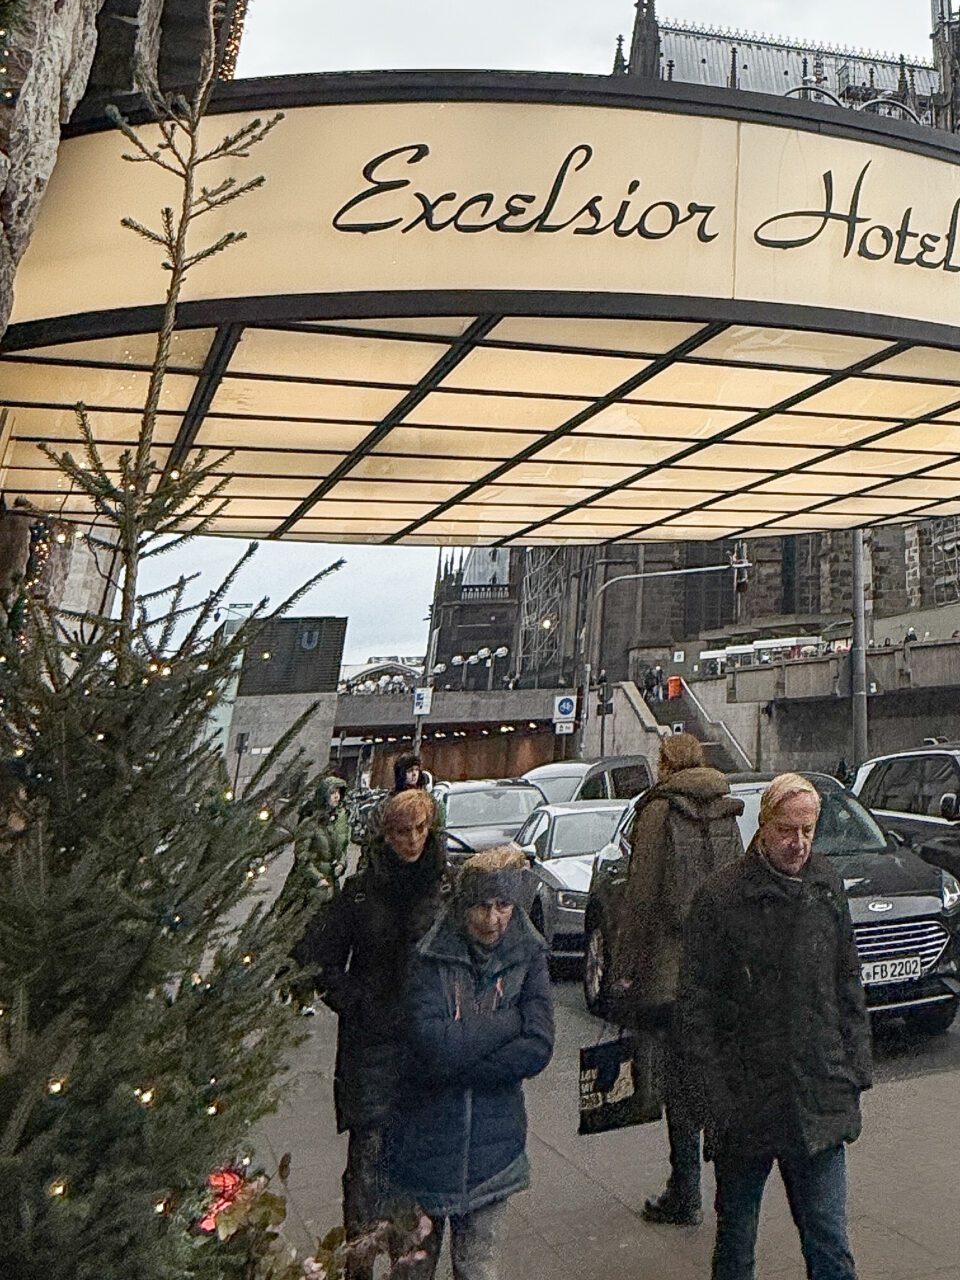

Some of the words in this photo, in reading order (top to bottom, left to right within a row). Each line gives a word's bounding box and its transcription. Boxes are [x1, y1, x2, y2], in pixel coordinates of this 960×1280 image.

[332, 143, 719, 243] Excelsior
[872, 964, 888, 980] FB
[890, 960, 918, 978] 2202
